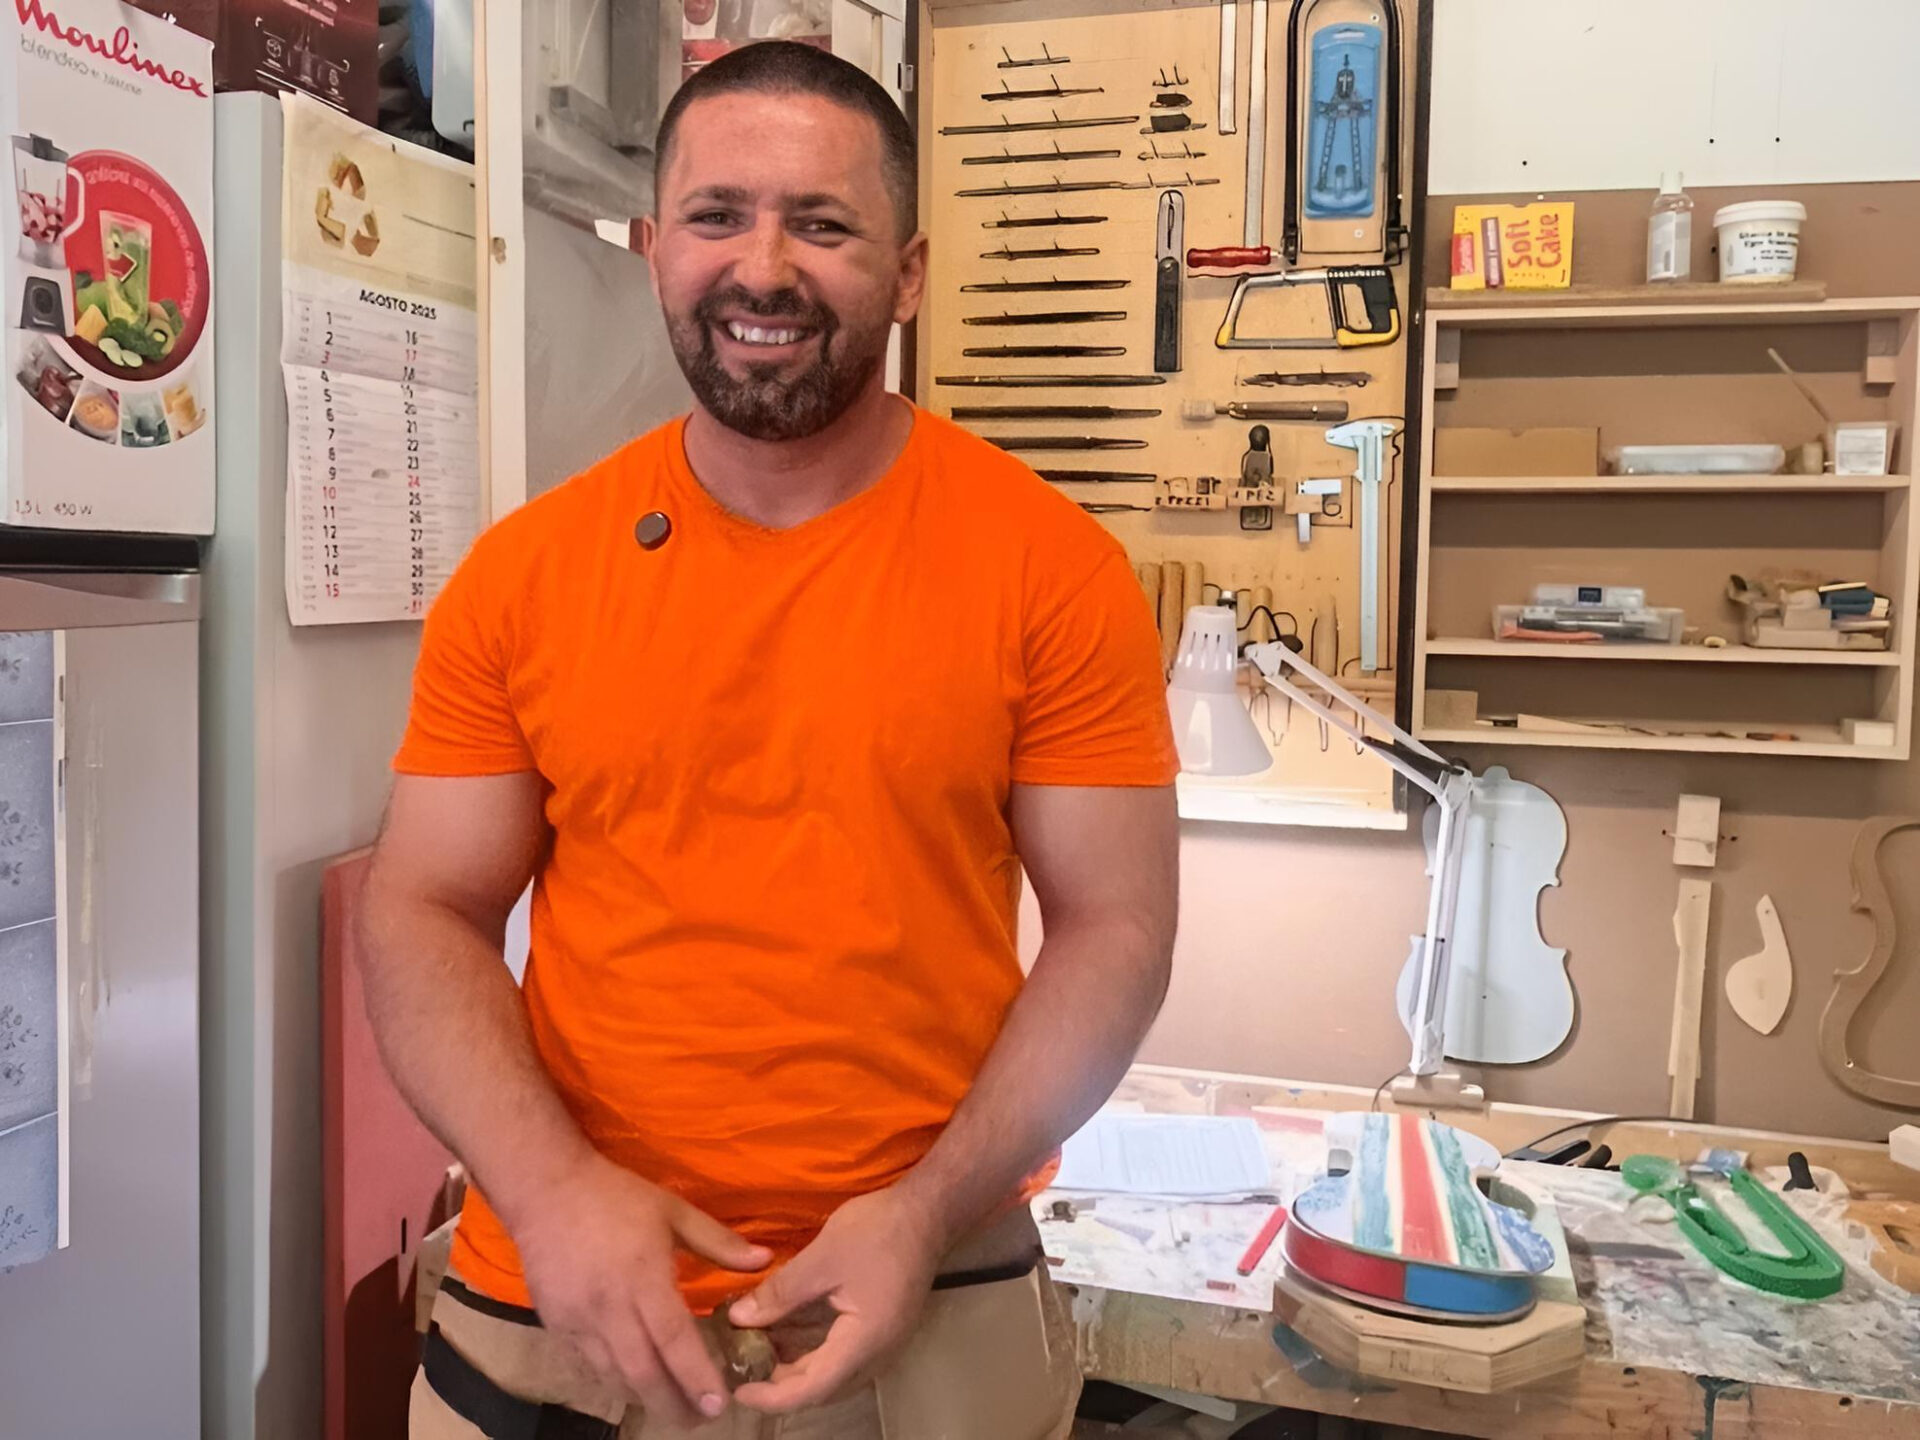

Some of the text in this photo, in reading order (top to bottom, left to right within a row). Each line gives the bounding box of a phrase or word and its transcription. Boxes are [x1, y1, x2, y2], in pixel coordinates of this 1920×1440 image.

[1505, 219, 1533, 268] Soft
[1535, 213, 1562, 268] Cake
[360, 289, 408, 313] AGOSTO
[326, 311, 332, 325] 1
[326, 331, 334, 346] 2
[321, 350, 330, 364] 3
[323, 388, 332, 402] 5
[326, 408, 335, 422] 6
[328, 427, 335, 440] 7
[328, 447, 336, 461] 8
[328, 466, 336, 480] 9
[323, 486, 336, 500] 10
[323, 505, 335, 519] 11
[323, 525, 337, 539] 12
[324, 544, 339, 559] 13
[324, 564, 339, 577] 14
[325, 583, 340, 598] 15
